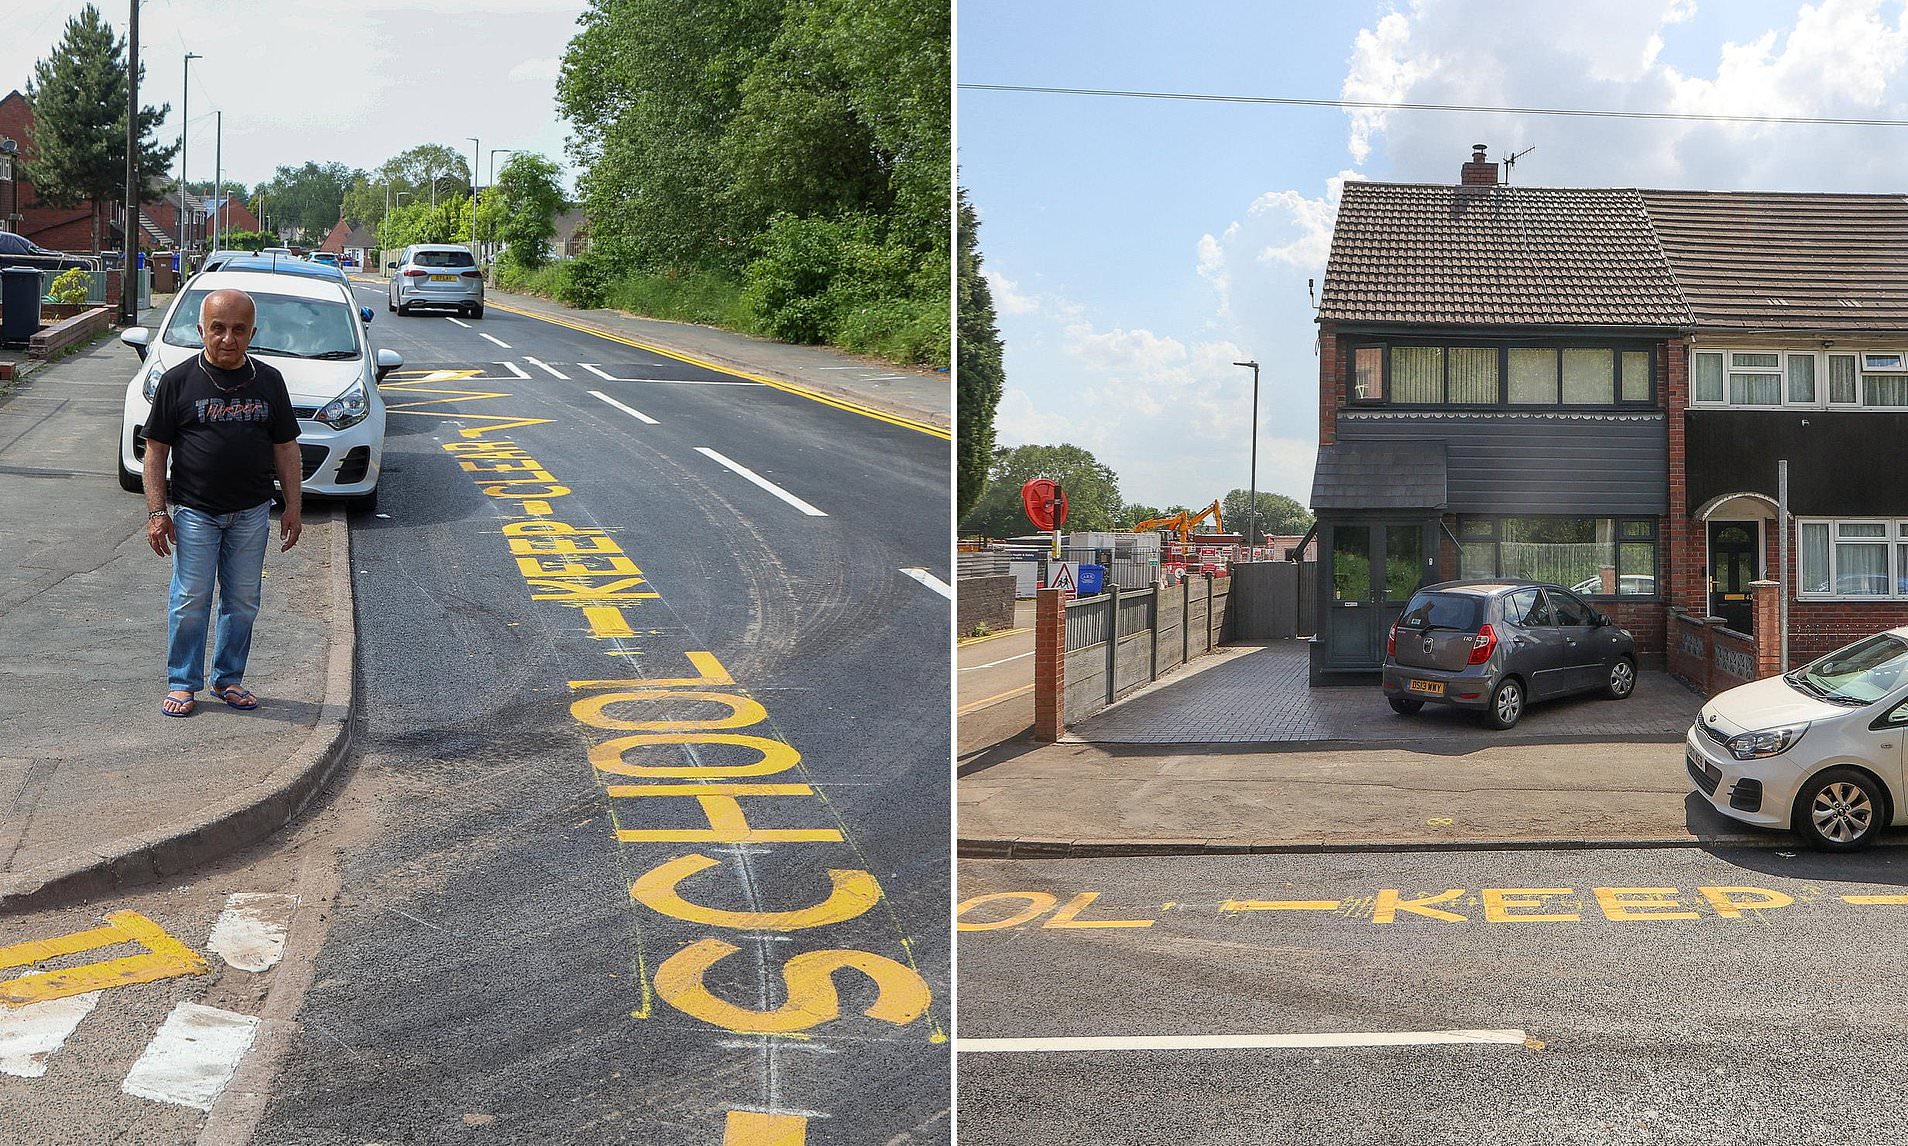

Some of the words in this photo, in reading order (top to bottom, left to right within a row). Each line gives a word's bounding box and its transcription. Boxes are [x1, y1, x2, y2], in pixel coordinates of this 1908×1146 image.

[195, 398, 269, 423] TRAIN
[441, 440, 571, 498] CLEAR
[502, 520, 661, 600] KEEP
[568, 651, 931, 1034] SCHOOL
[957, 890, 1155, 932] OL
[1371, 886, 1795, 923] KEEP
